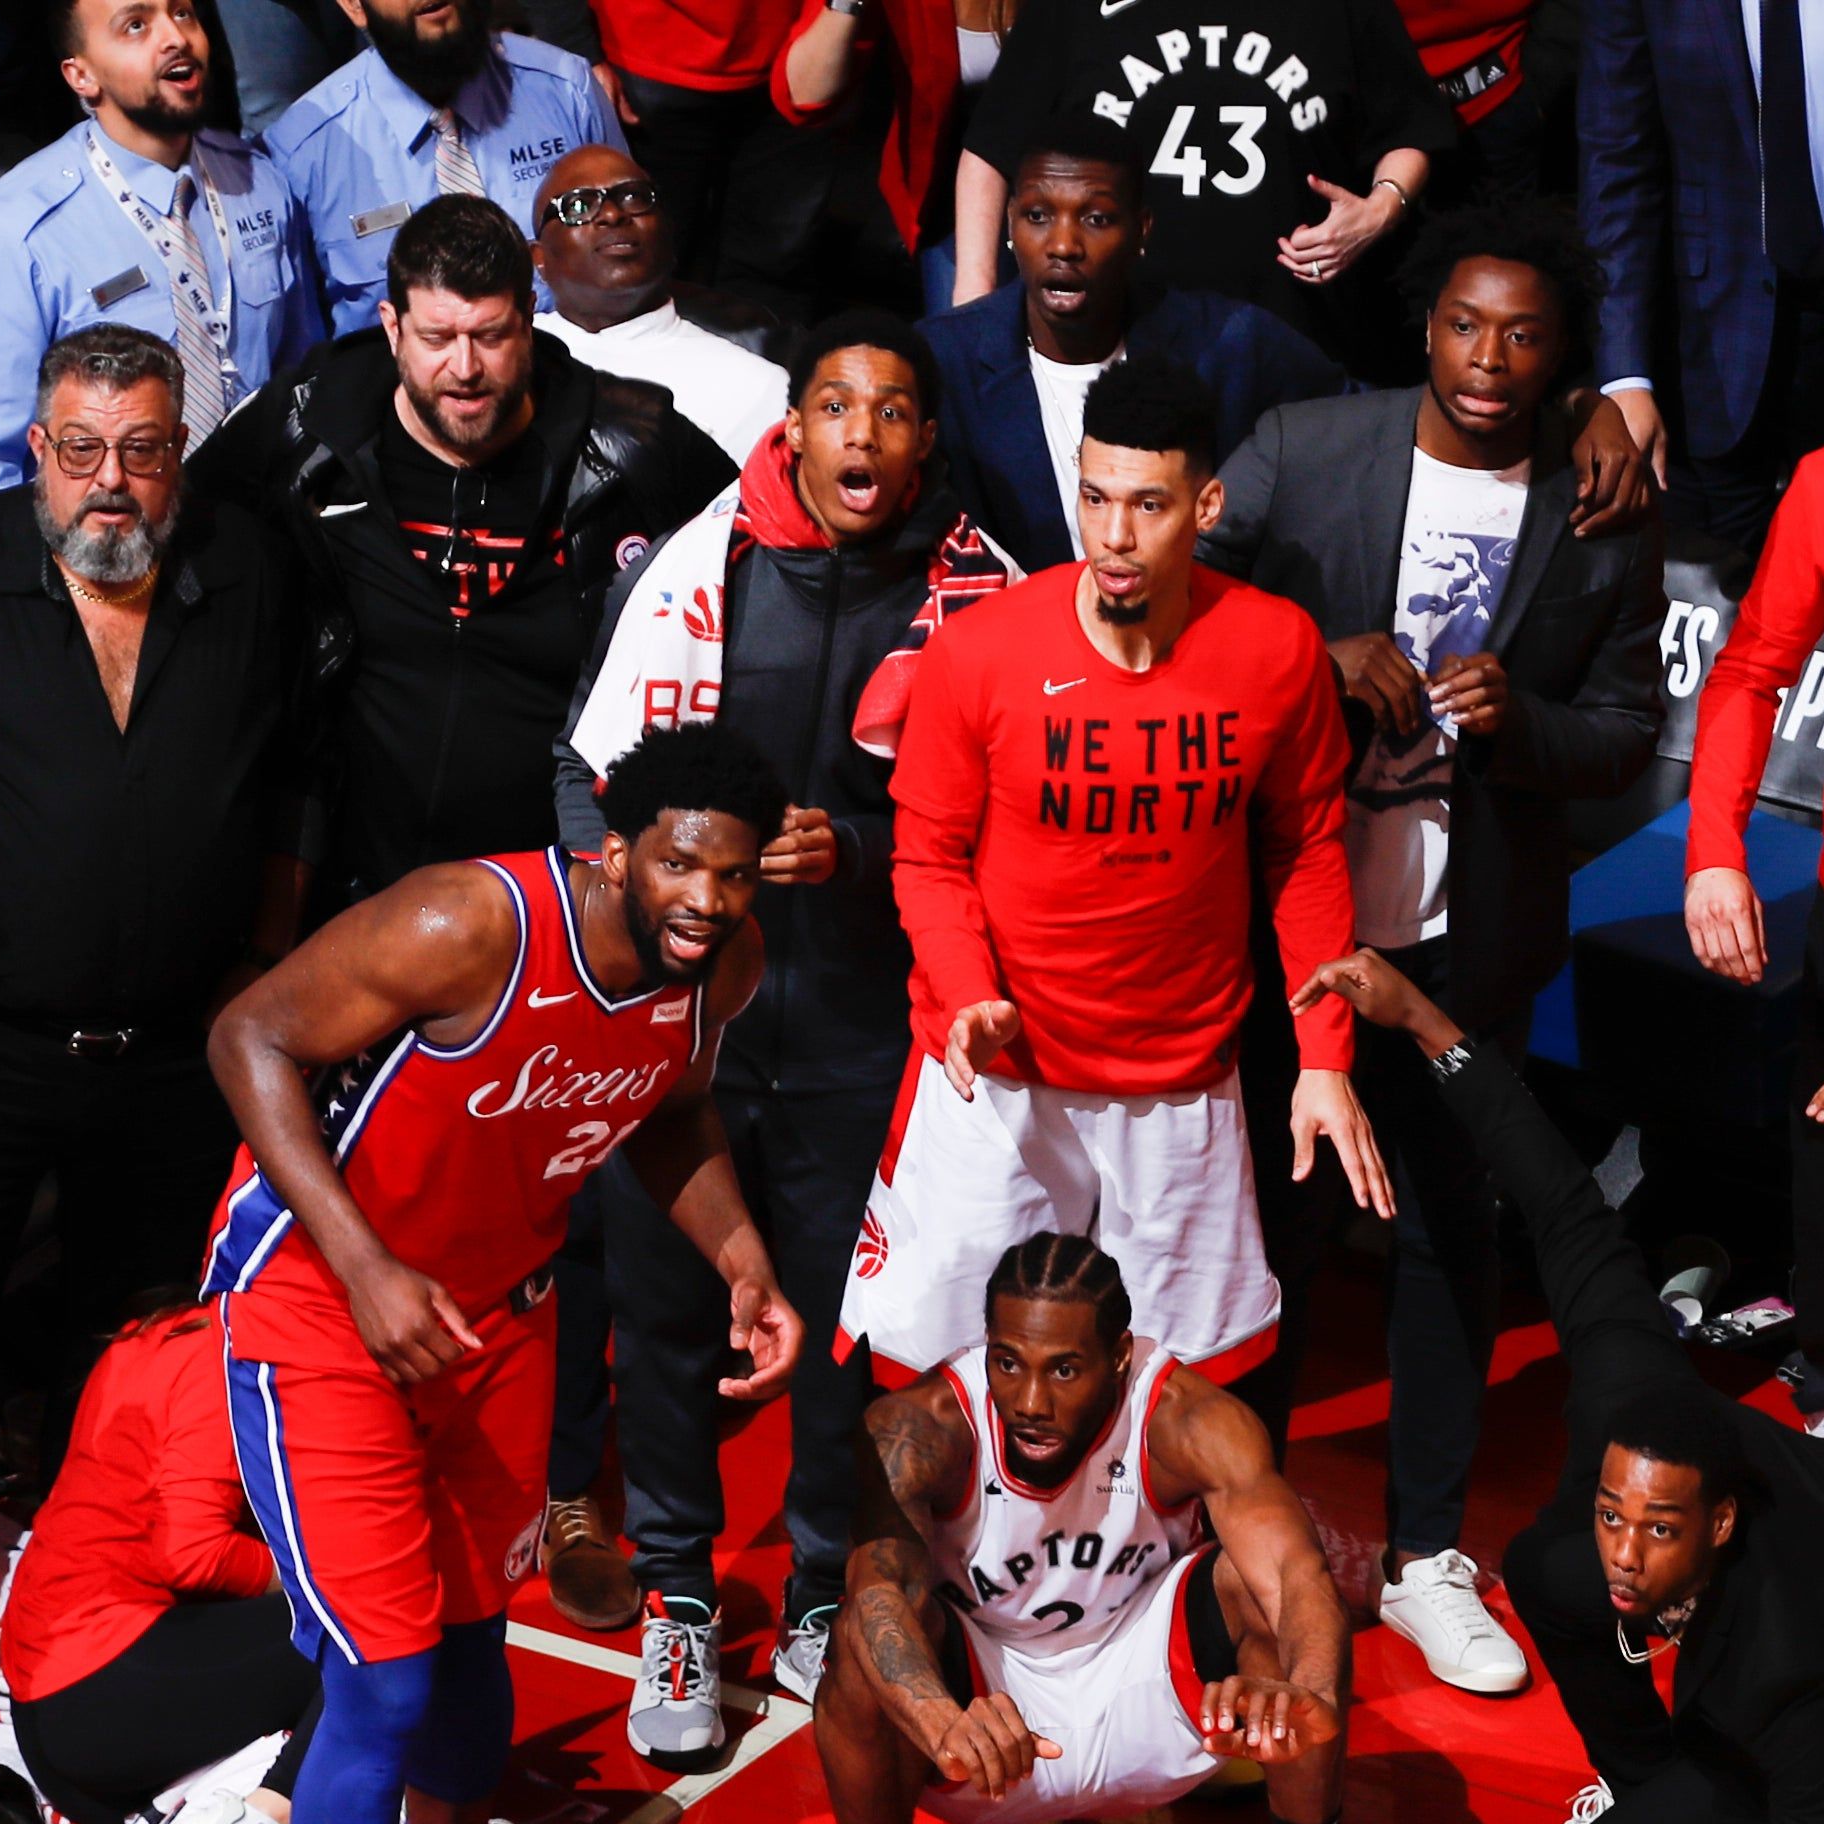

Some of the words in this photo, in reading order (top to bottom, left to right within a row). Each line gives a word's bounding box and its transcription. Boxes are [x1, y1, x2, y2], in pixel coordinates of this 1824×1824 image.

[1093, 25, 1328, 132] RAPTORS
[511, 137, 565, 165] MLSE
[513, 159, 555, 182] SECUR
[1149, 105, 1267, 197] 43
[133, 206, 155, 232] MLSE
[236, 209, 274, 235] MLSE
[189, 288, 208, 314] MLSE
[1045, 714, 1110, 773] WE
[1136, 710, 1241, 775] THE
[1040, 775, 1242, 835] NORTH
[466, 1044, 670, 1118] Sixers
